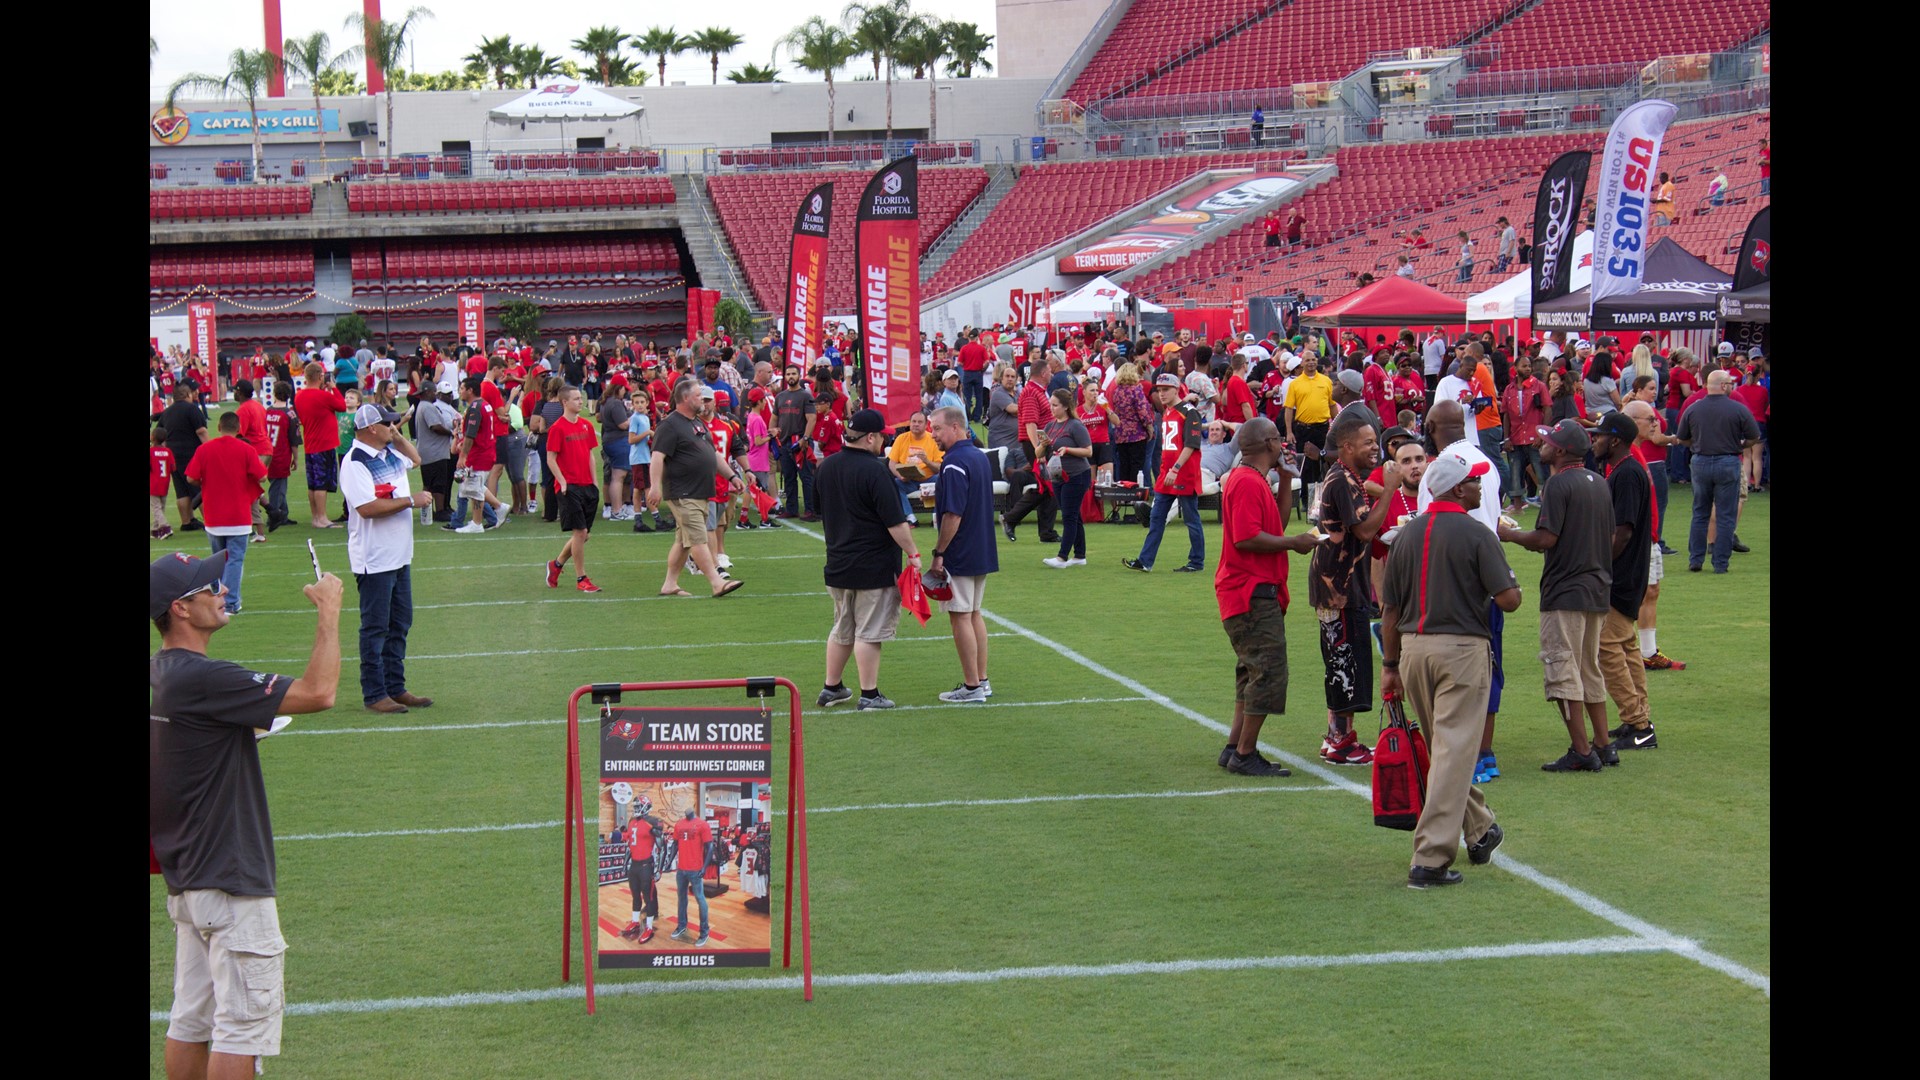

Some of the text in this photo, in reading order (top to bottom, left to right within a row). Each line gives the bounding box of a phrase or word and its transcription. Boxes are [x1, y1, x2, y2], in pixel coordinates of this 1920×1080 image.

[203, 117, 279, 130] CAPTAN'S
[1610, 150, 1624, 176] FOR
[874, 195, 910, 205] FLORIDA
[1605, 179, 1619, 210] NEW
[872, 204, 913, 215] HOSPITAL
[1594, 212, 1613, 275] COUNTRY
[1074, 253, 1098, 269] TEAM
[1099, 252, 1127, 267] STORE
[888, 234, 911, 342] LOUNGE
[1536, 311, 1587, 327] WWW.98ROCK.COM
[1612, 313, 1656, 324] TAMPA
[1659, 311, 1696, 322] BAY'S
[867, 264, 888, 405] RECHARGE
[375, 367, 393, 380] 40
[158, 460, 167, 478] 3
[648, 723, 764, 742] TEAM STORE
[604, 759, 765, 772] ENTRANCE AT SOUTHWEST CORNER
[652, 955, 715, 966] #GOBUCS
